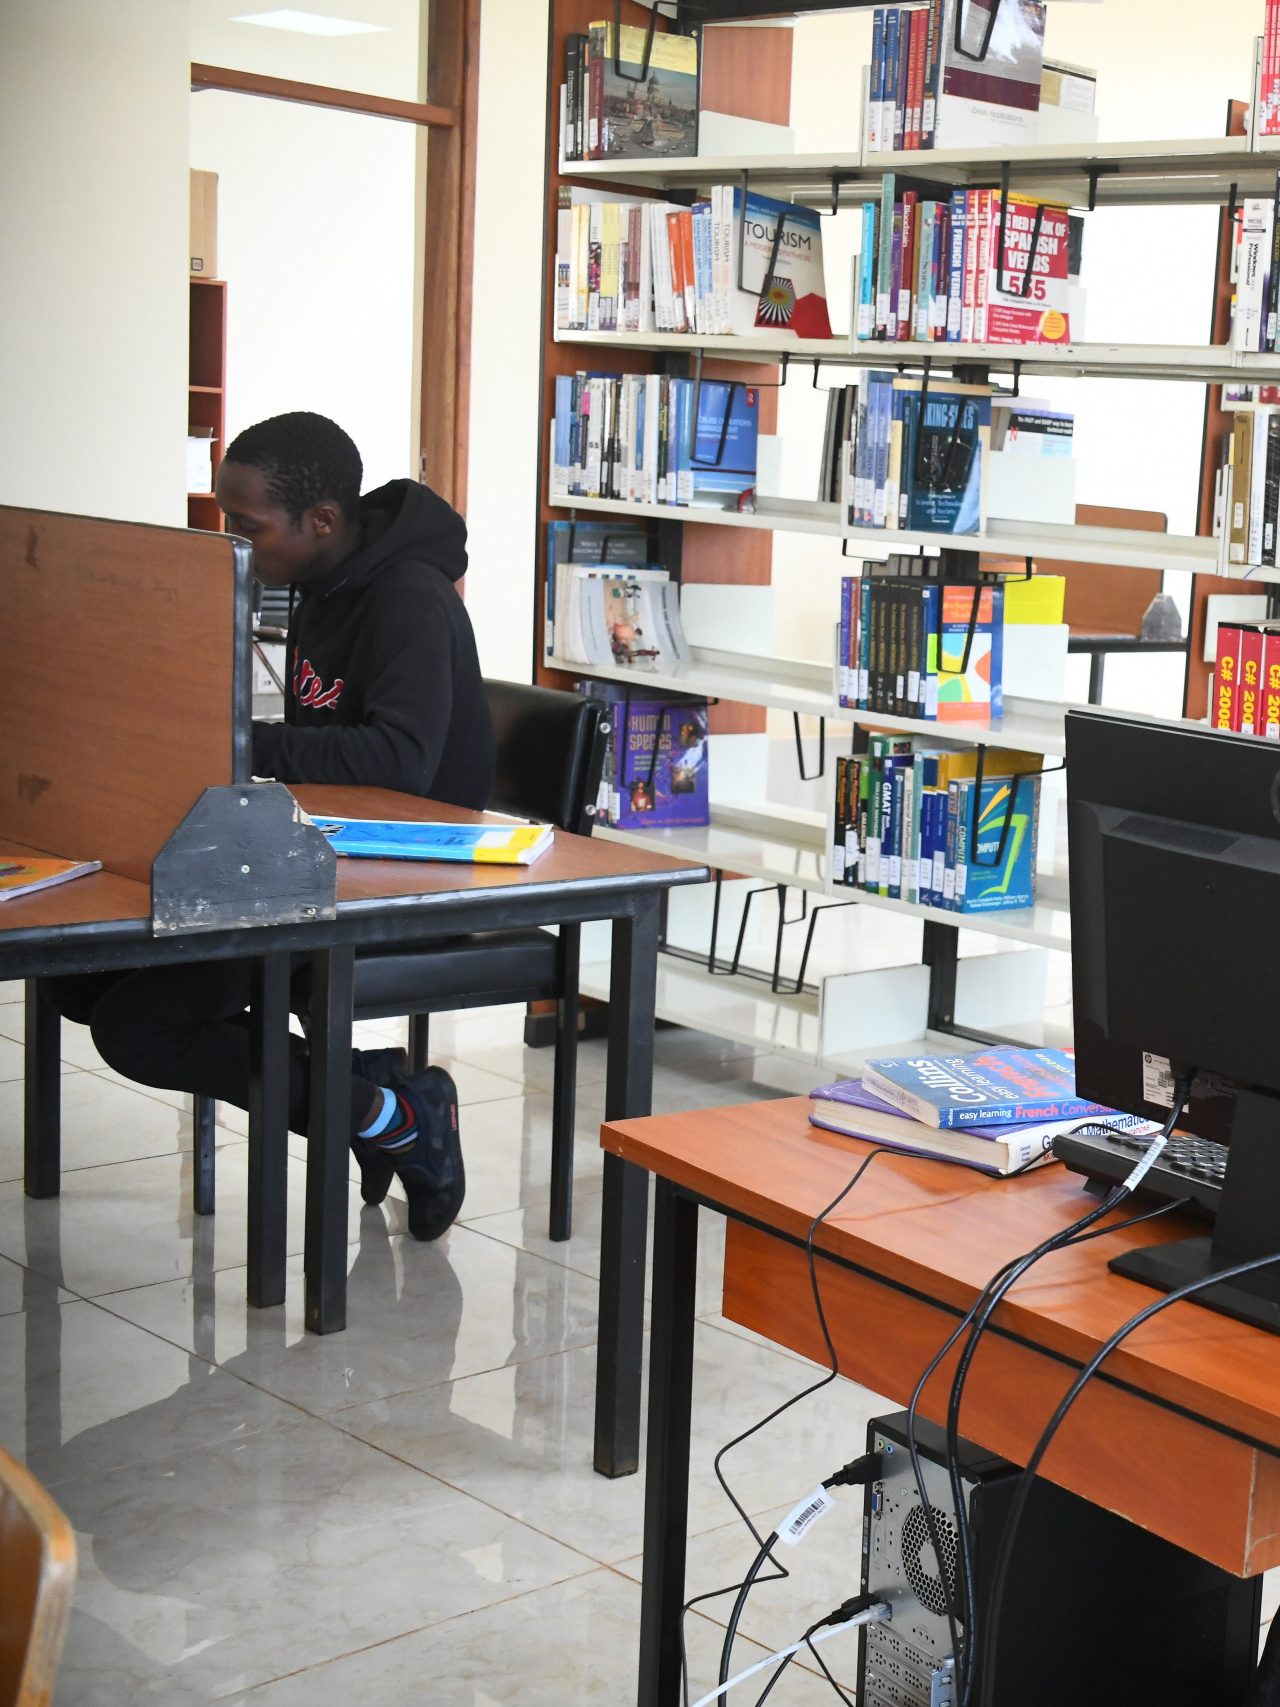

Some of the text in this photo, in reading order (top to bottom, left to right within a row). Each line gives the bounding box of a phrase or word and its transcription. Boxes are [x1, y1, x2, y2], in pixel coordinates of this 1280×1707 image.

[1251, 242, 1260, 278] Windows
[1221, 655, 1234, 682] C#
[1243, 660, 1257, 723] C# 200
[631, 715, 671, 732] HUMN
[1267, 695, 1280, 724] 200
[630, 734, 672, 751] SPECES
[882, 782, 892, 815] GMAT
[904, 820, 912, 860] Mathemati
[958, 825, 967, 865] COMPUTE
[908, 1058, 987, 1103] Collins
[959, 1101, 1119, 1121] easy learning French Conversa
[1086, 1113, 1148, 1137] Mathematic
